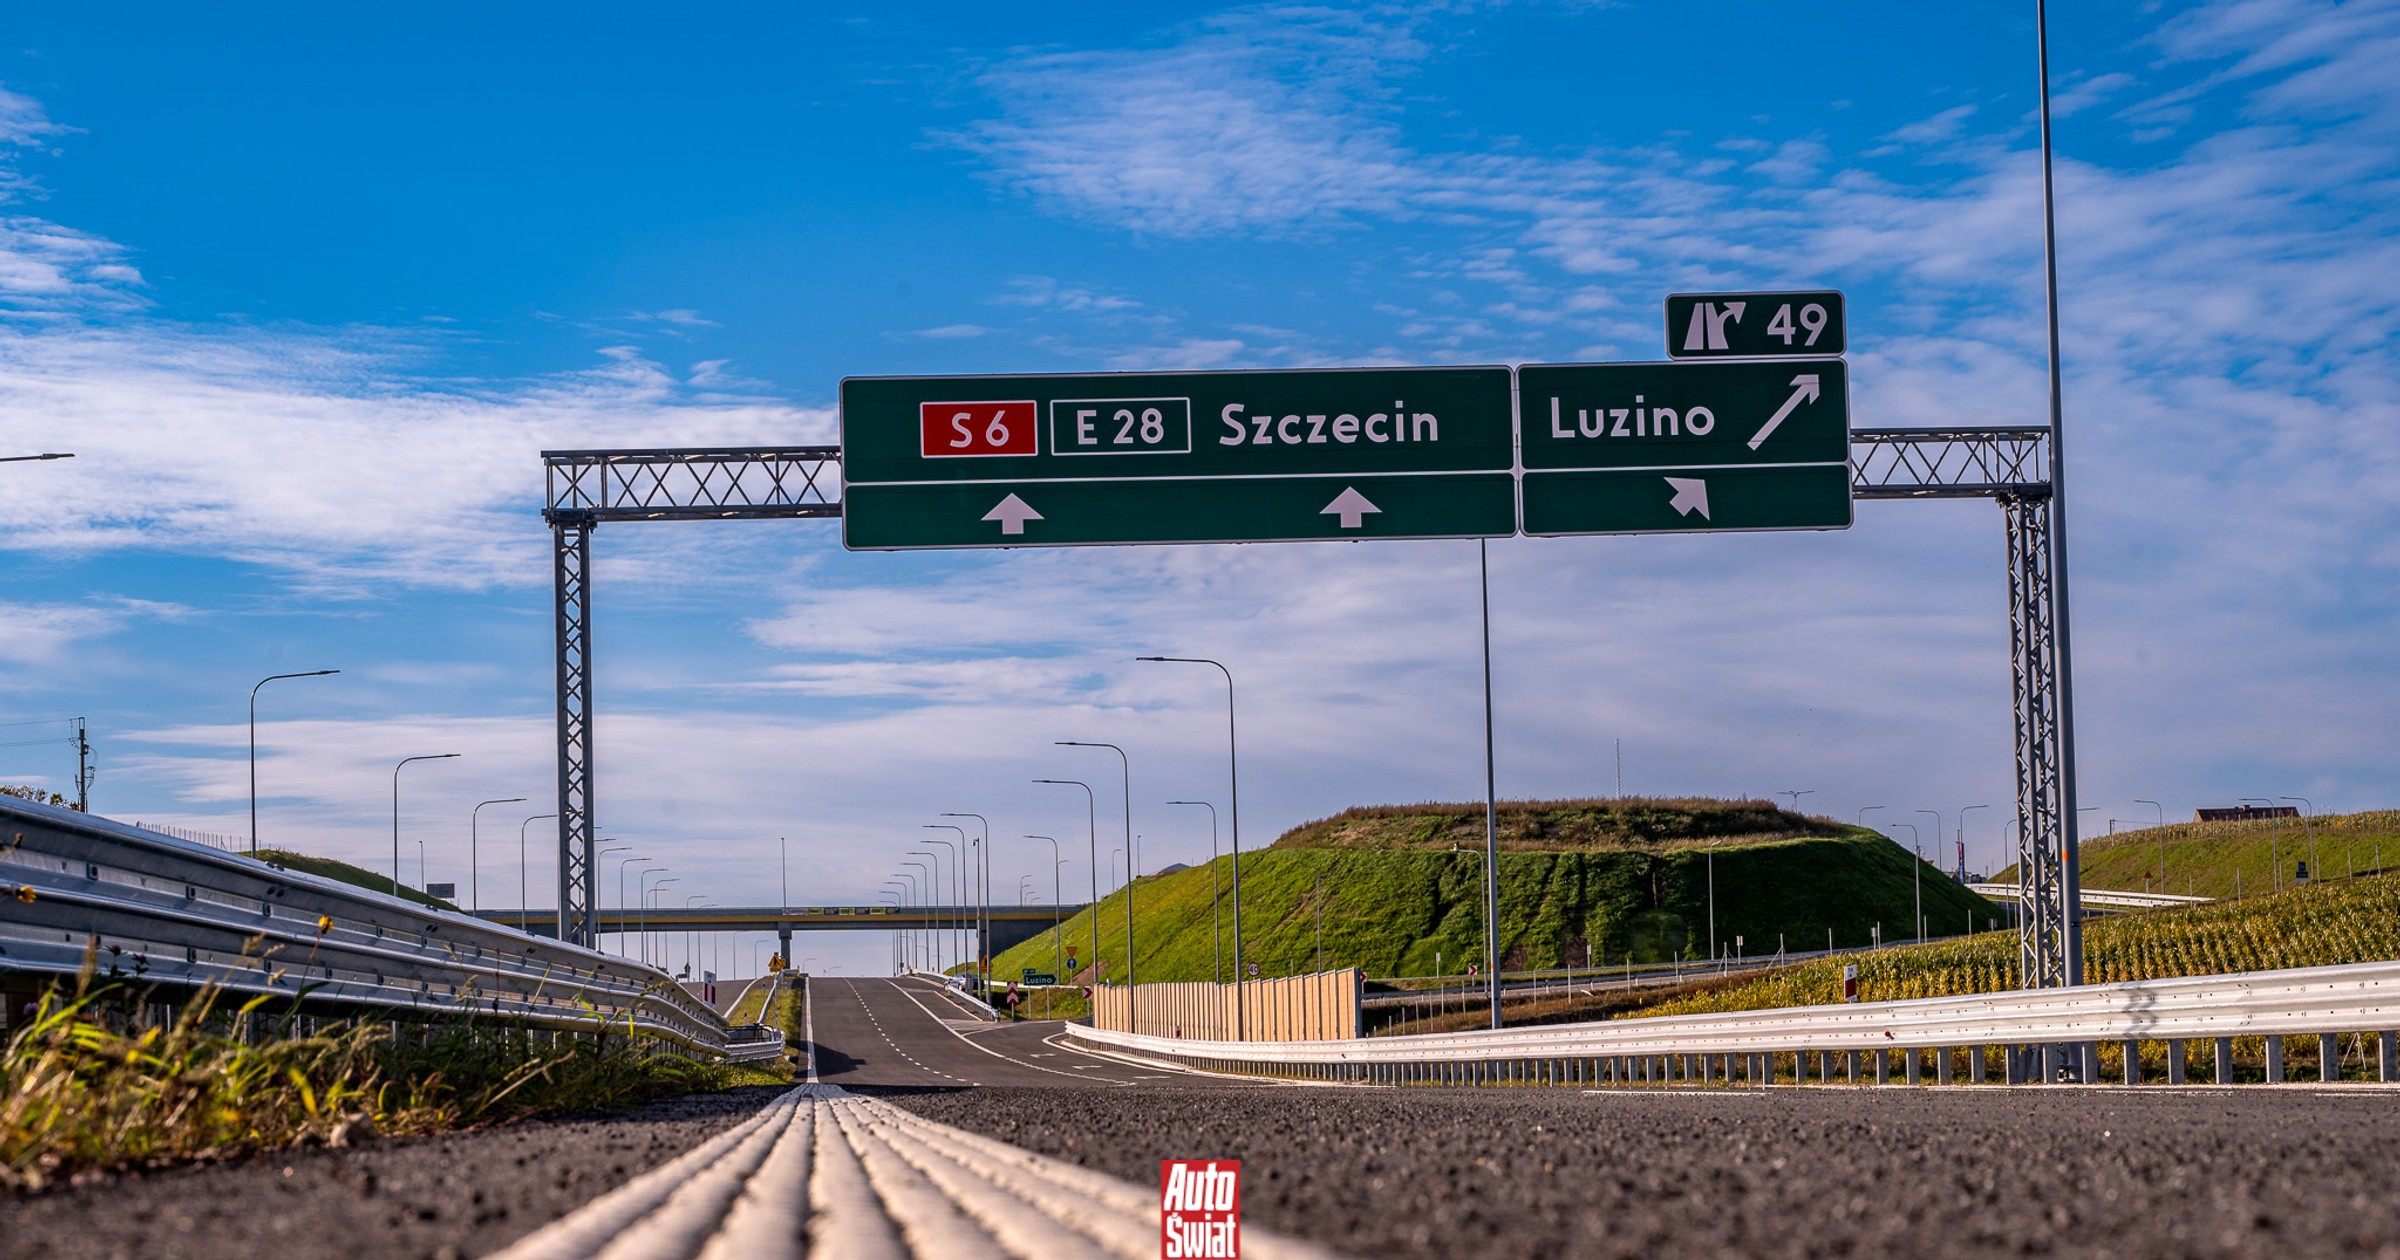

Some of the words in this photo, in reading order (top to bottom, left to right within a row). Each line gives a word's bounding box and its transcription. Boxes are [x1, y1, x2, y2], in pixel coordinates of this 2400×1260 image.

[1767, 304, 1827, 346] 49
[949, 413, 972, 448] S
[985, 410, 1010, 446] 6
[1077, 410, 1098, 445] E
[1113, 408, 1164, 444] 28
[1220, 401, 1438, 446] Szczecin
[1551, 395, 1715, 438] Luzino
[1026, 976, 1052, 984] Luzino
